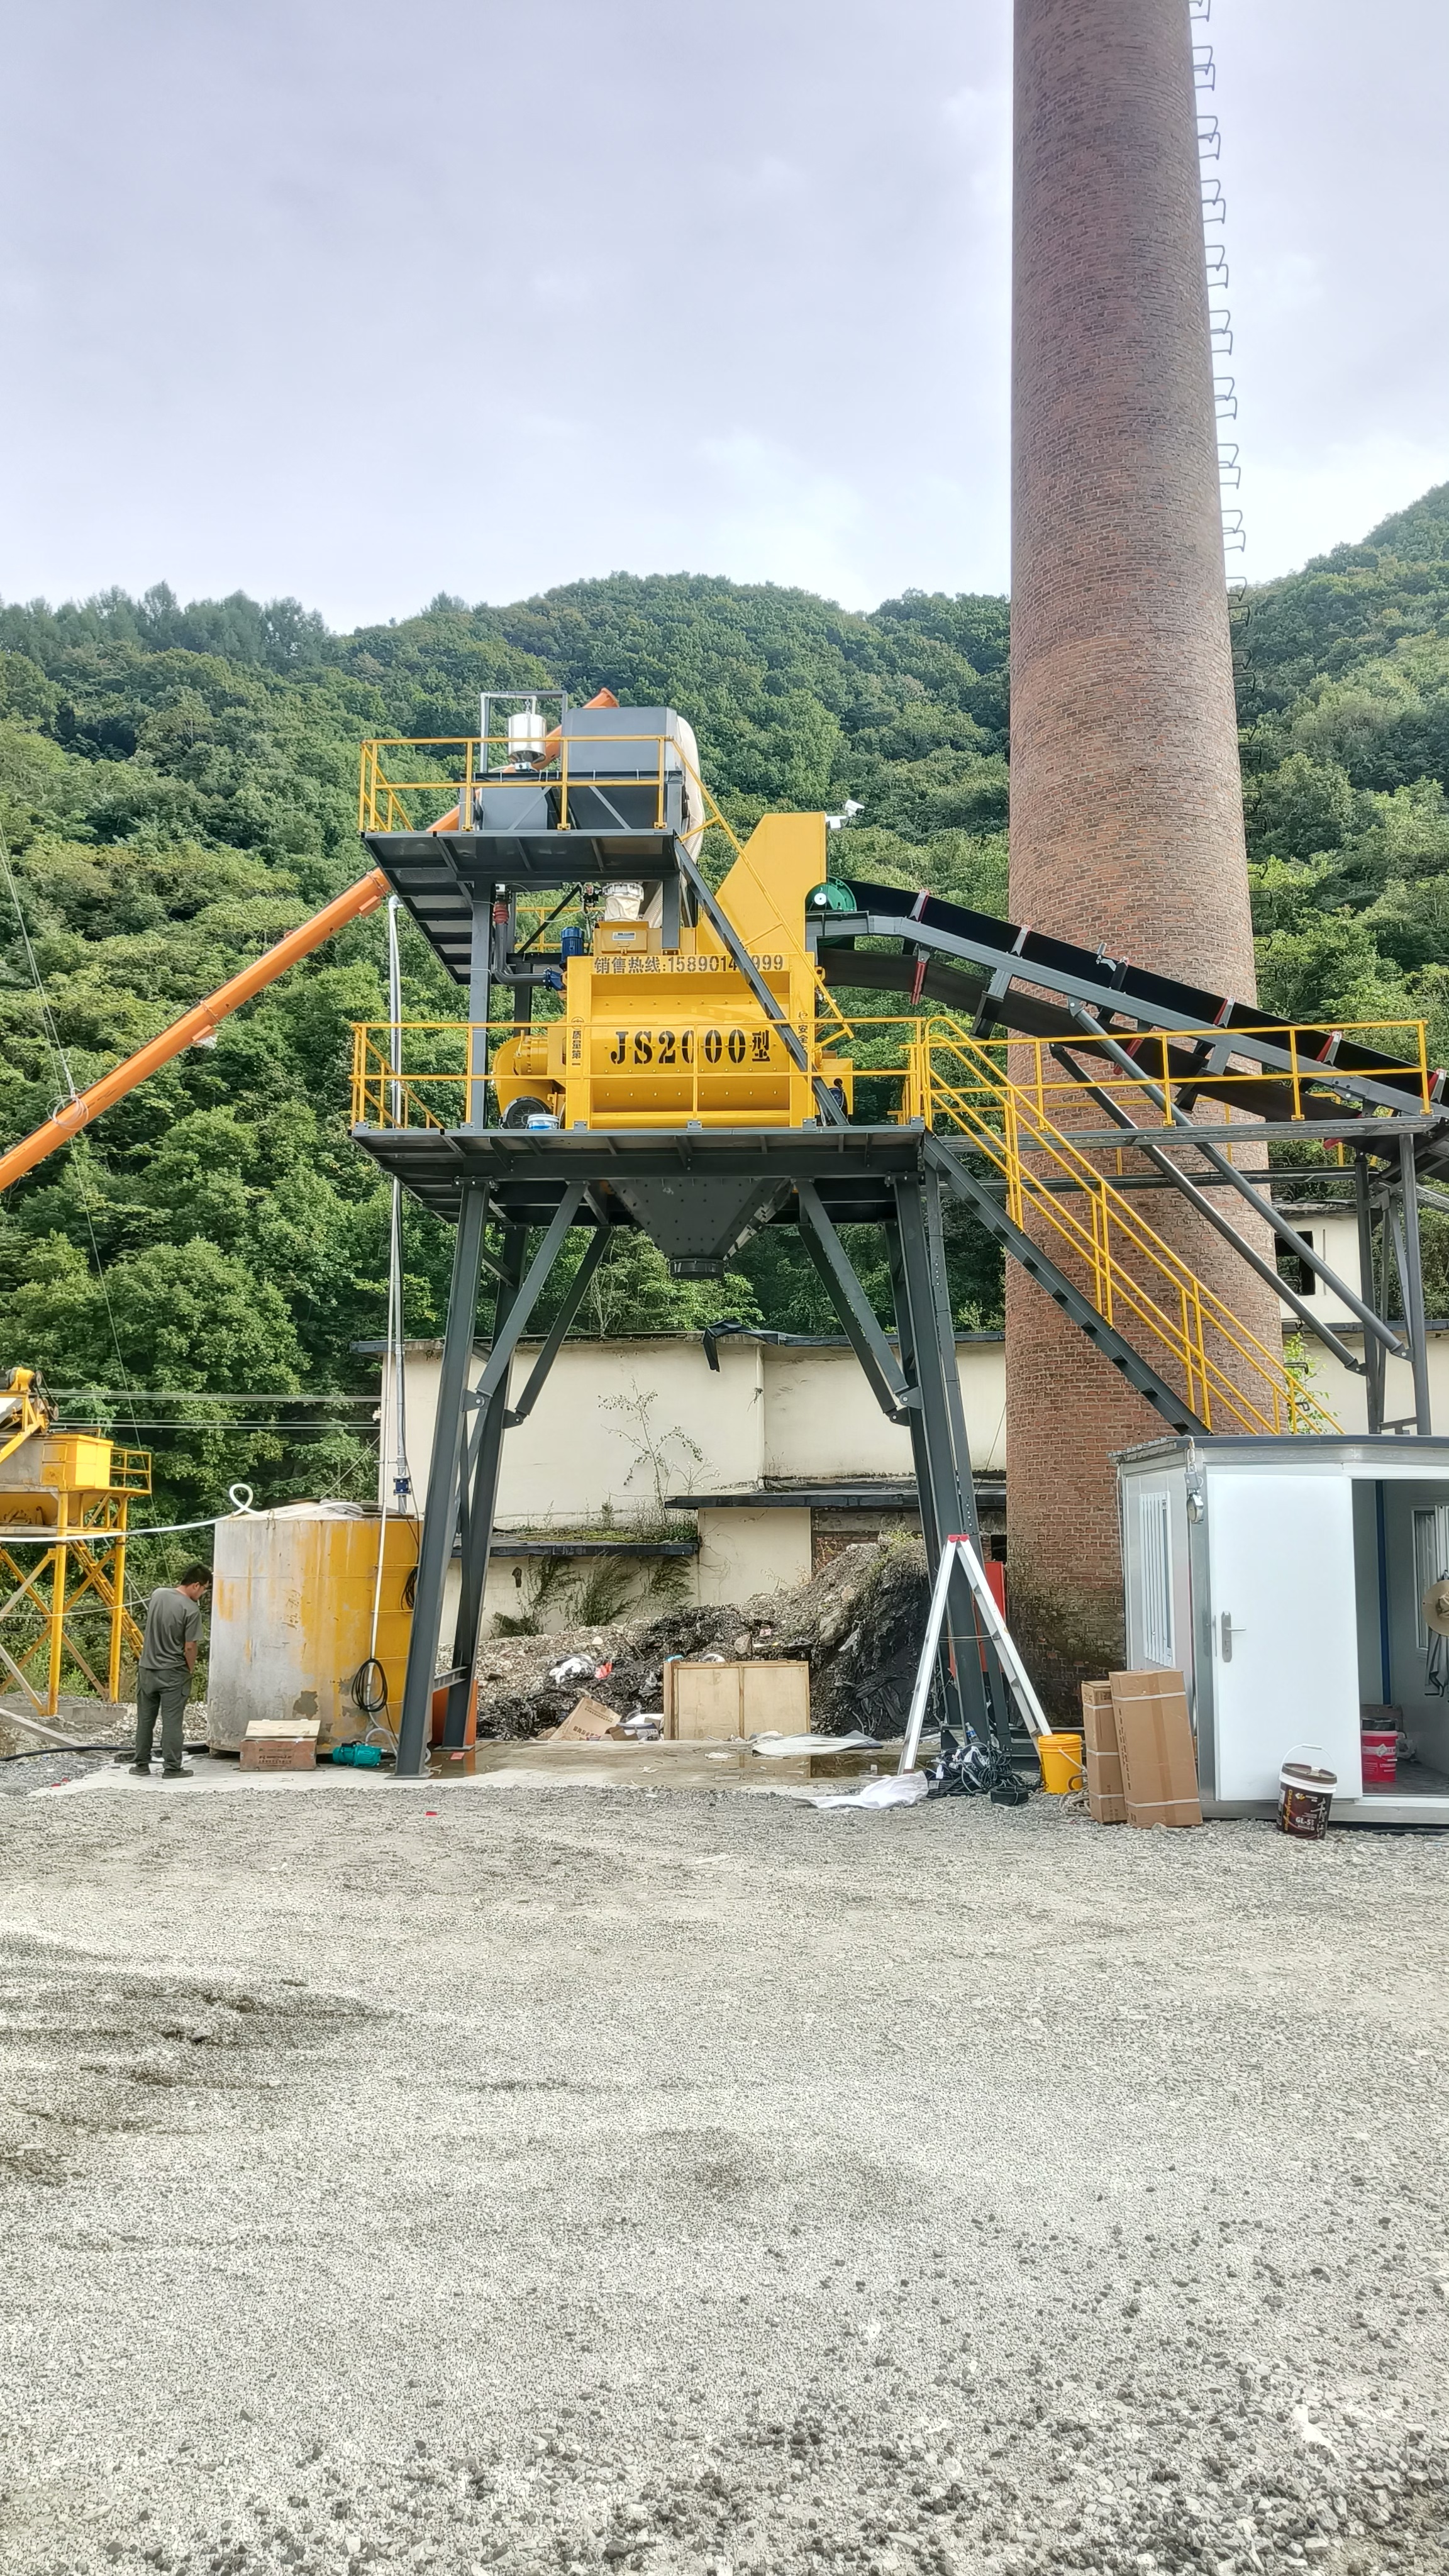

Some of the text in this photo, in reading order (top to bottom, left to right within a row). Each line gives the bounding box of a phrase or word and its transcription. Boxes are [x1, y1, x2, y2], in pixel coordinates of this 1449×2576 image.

[594, 954, 784, 974] 销售热线:1589014999
[572, 1030, 581, 1066] 质量第一
[610, 1029, 770, 1065] JS2000型
